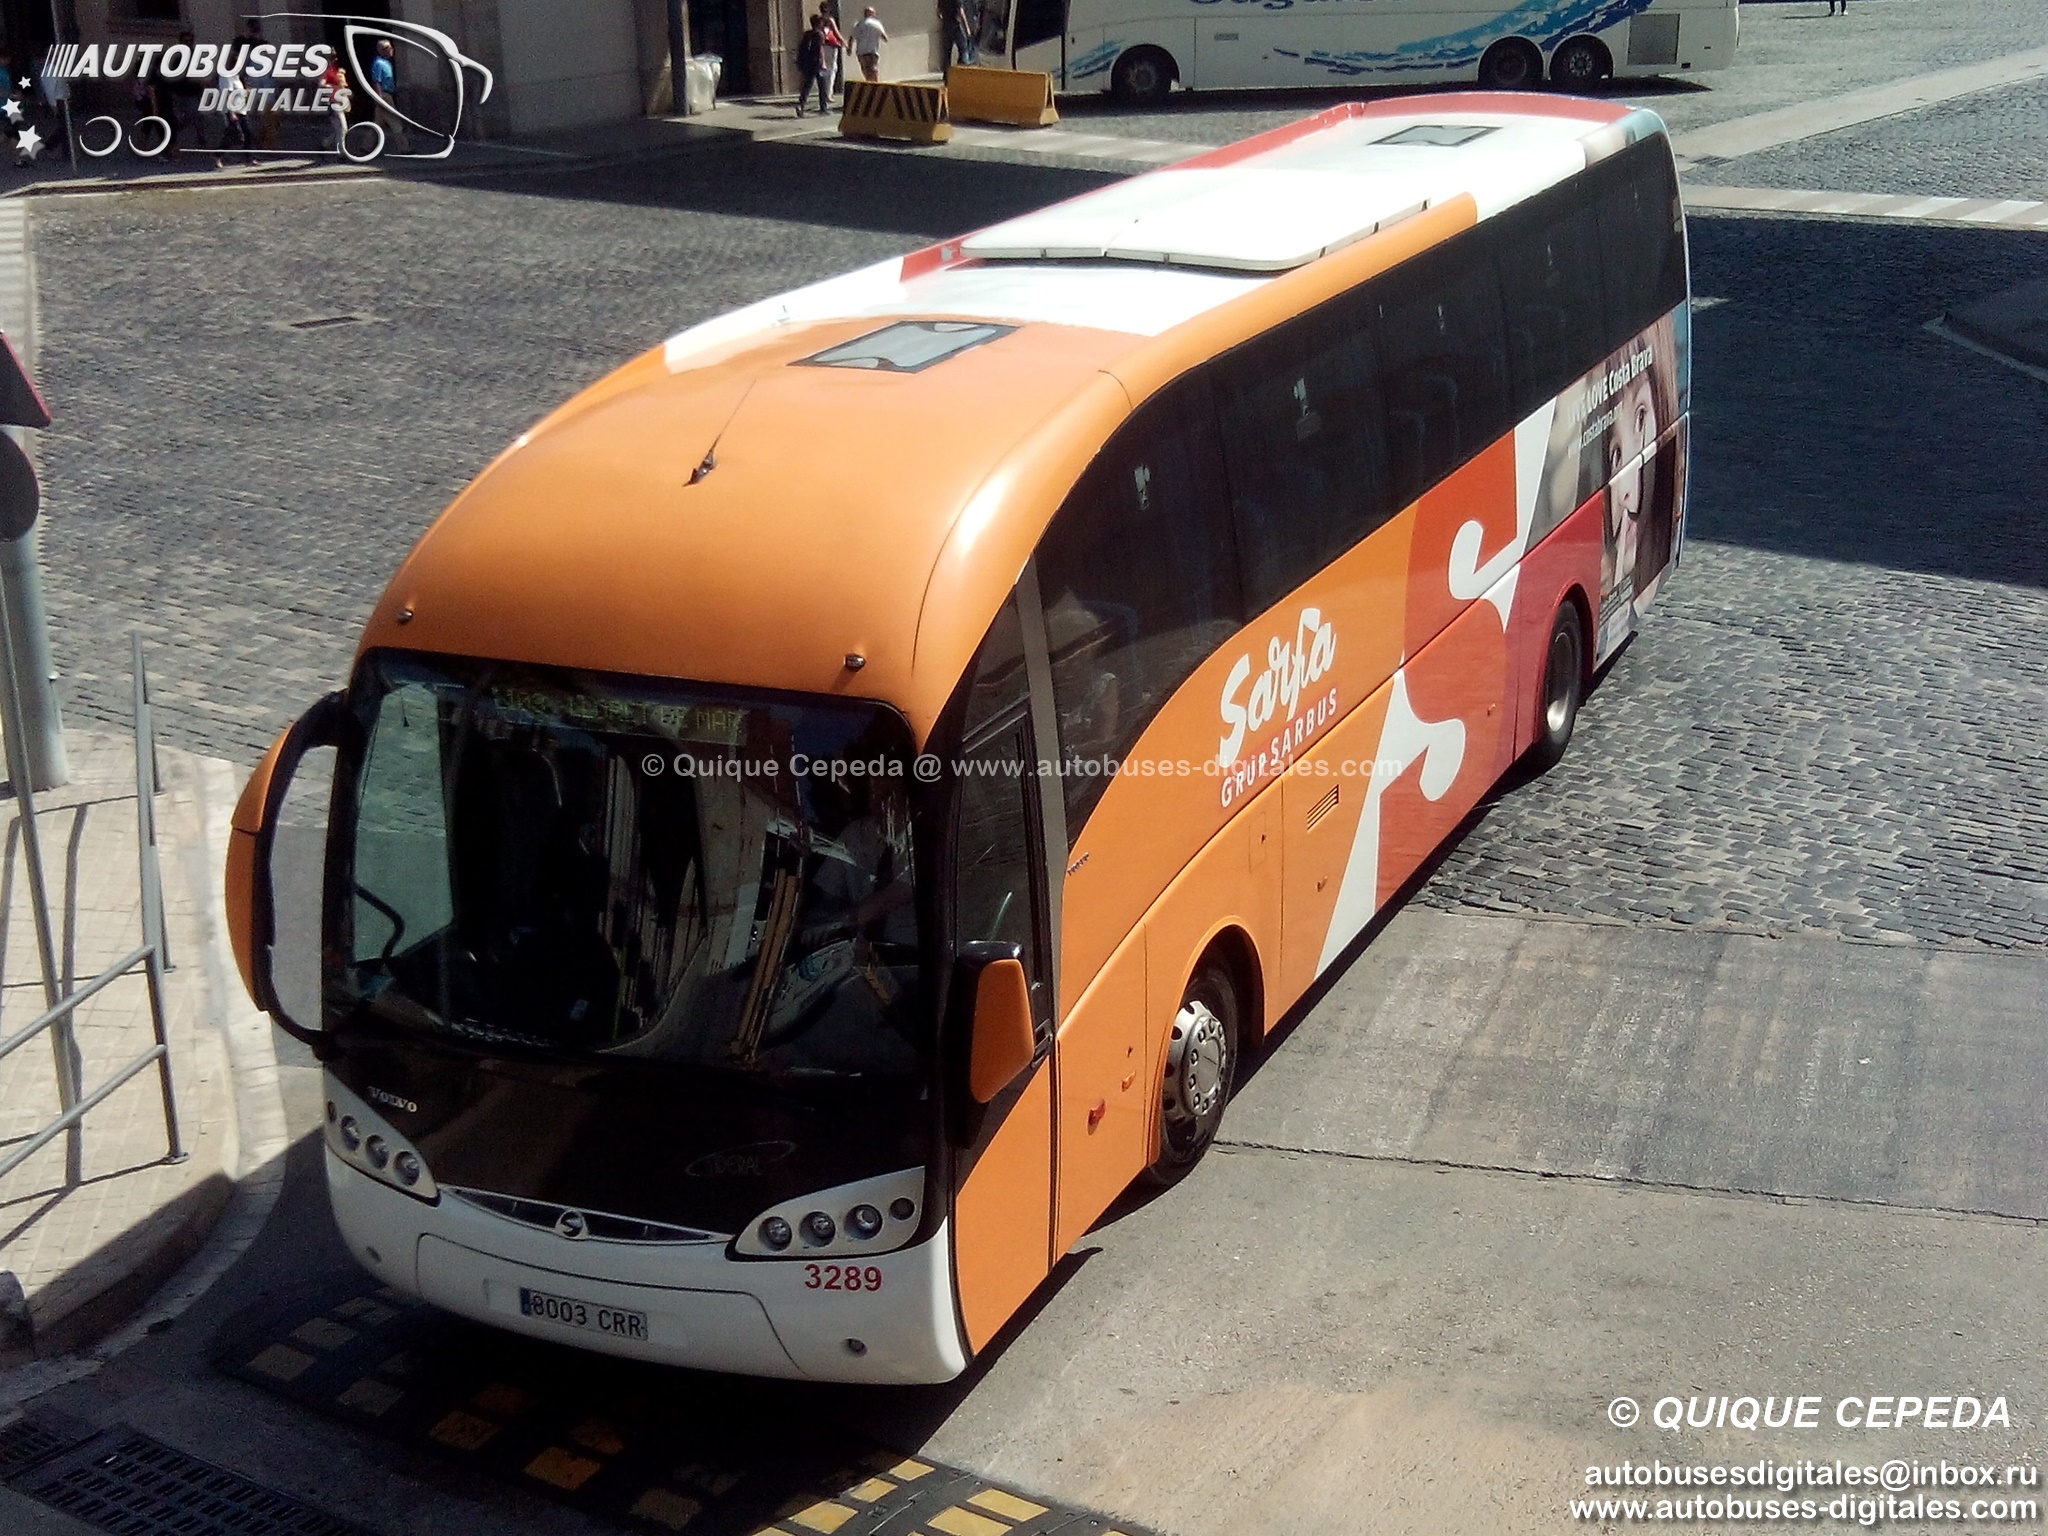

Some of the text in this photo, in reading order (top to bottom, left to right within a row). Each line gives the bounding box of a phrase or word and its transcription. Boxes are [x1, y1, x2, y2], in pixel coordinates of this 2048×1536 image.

[1587, 377, 1608, 414] LOVE
[1609, 363, 1631, 396] Costa
[1631, 346, 1653, 378] Brava
[1219, 607, 1338, 769] Sarfa
[1220, 687, 1338, 808] GRUP SARBUS
[366, 1085, 418, 1113] VOLVO
[803, 1263, 883, 1292] 3289
[533, 1294, 641, 1337] 8003 CRR
